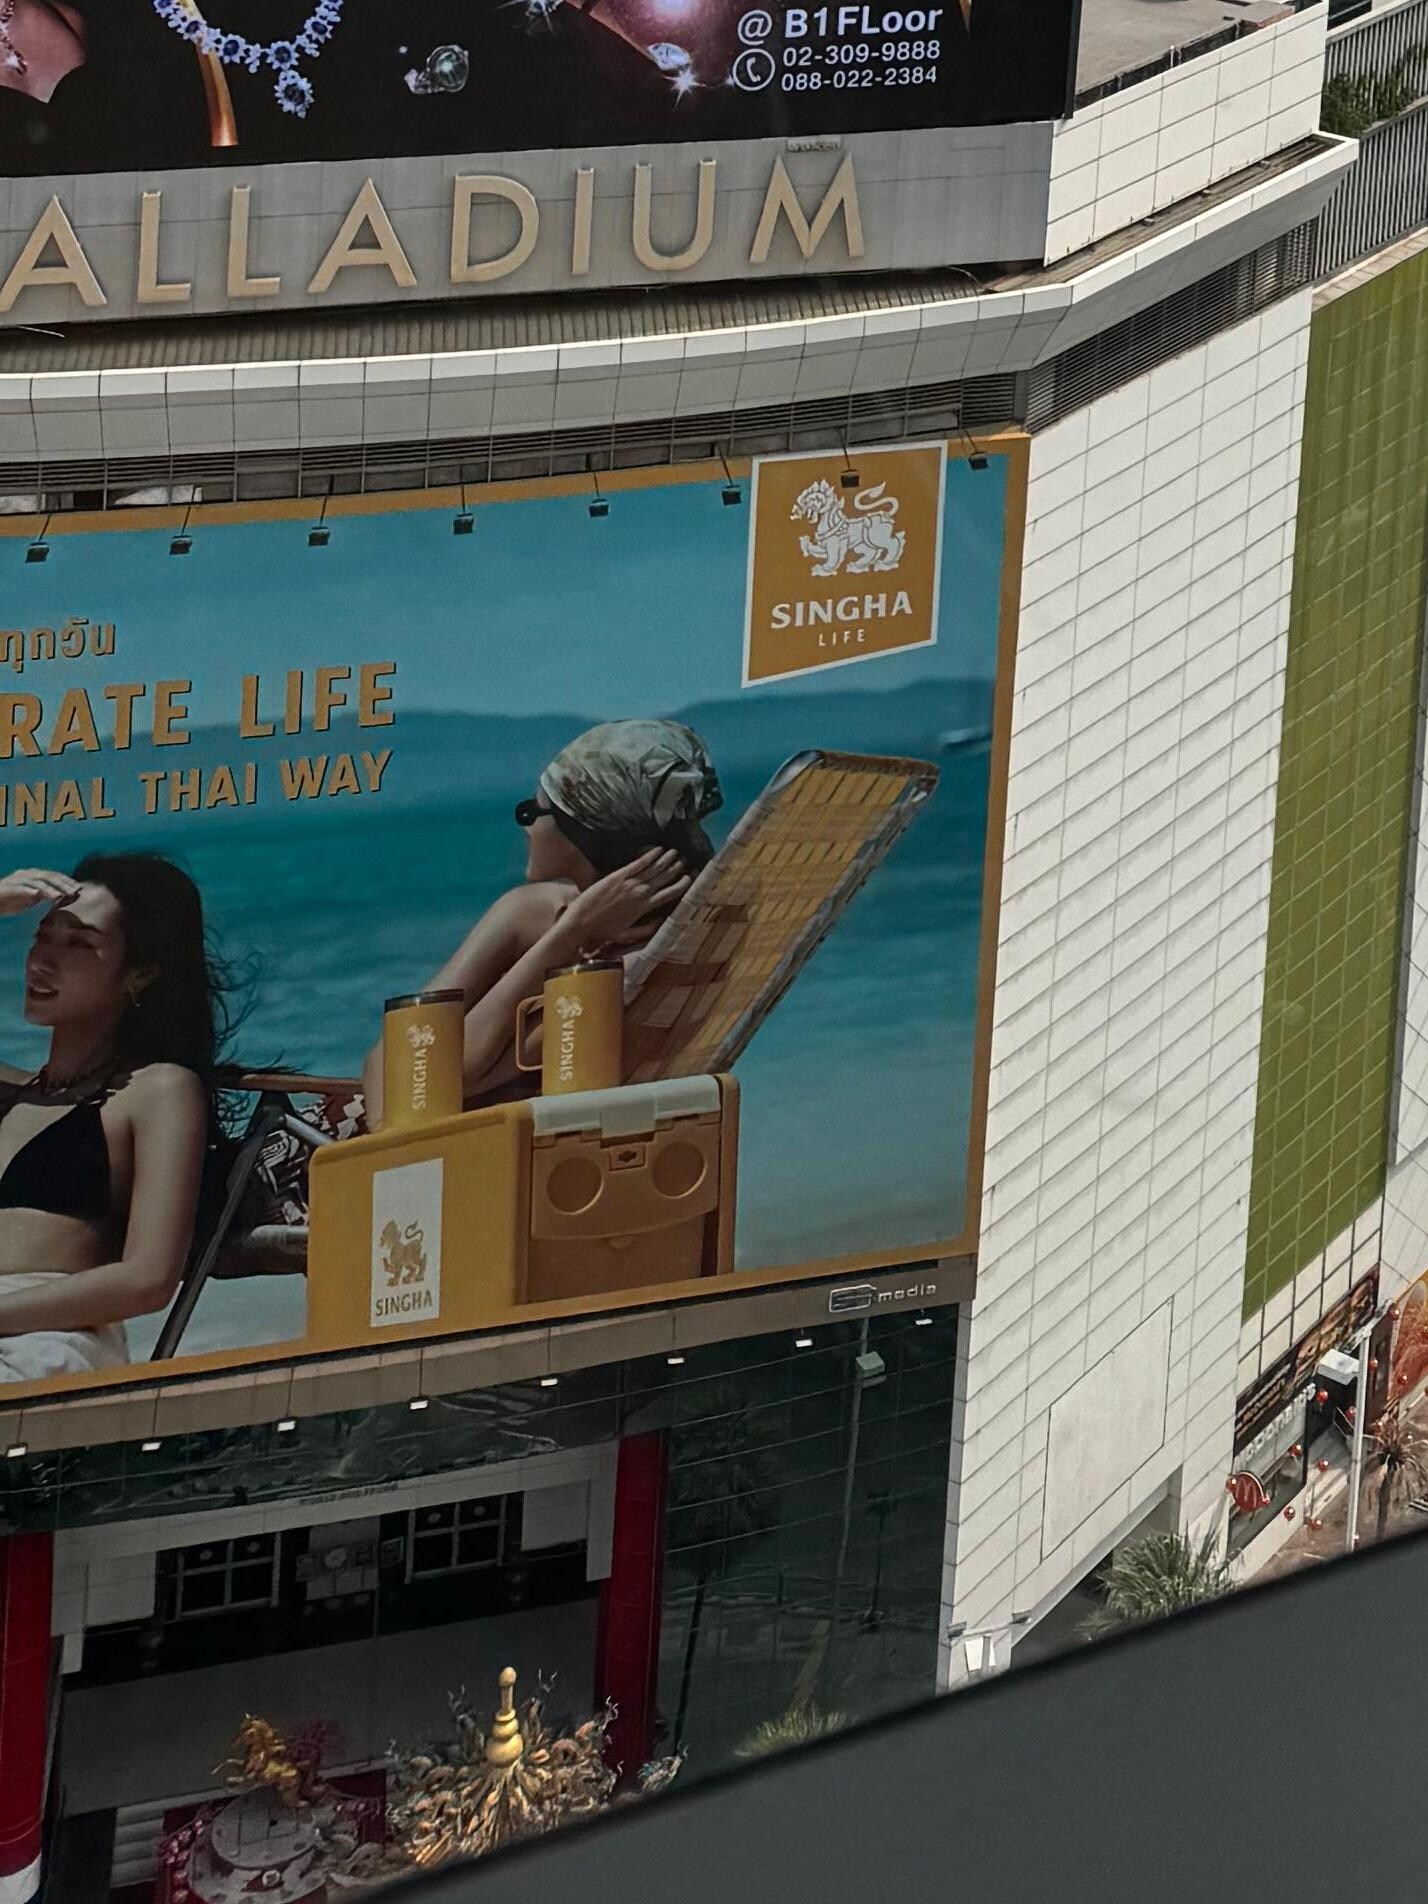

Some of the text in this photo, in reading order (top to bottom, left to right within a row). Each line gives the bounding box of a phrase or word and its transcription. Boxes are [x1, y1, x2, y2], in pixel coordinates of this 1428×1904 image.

[782, 40, 941, 67] 02-309-9888
[780, 65, 938, 92] 088-022-2384
[770, 590, 913, 629] SINGHA
[818, 629, 866, 647] LIFE
[240, 661, 397, 738] LIFE
[139, 762, 257, 815] THAI
[279, 749, 394, 801] WAY
[560, 1018, 575, 1081] SINGHA
[412, 1047, 428, 1110] SINGHA
[375, 1289, 433, 1317] SINGHA
[878, 1283, 937, 1302] media
